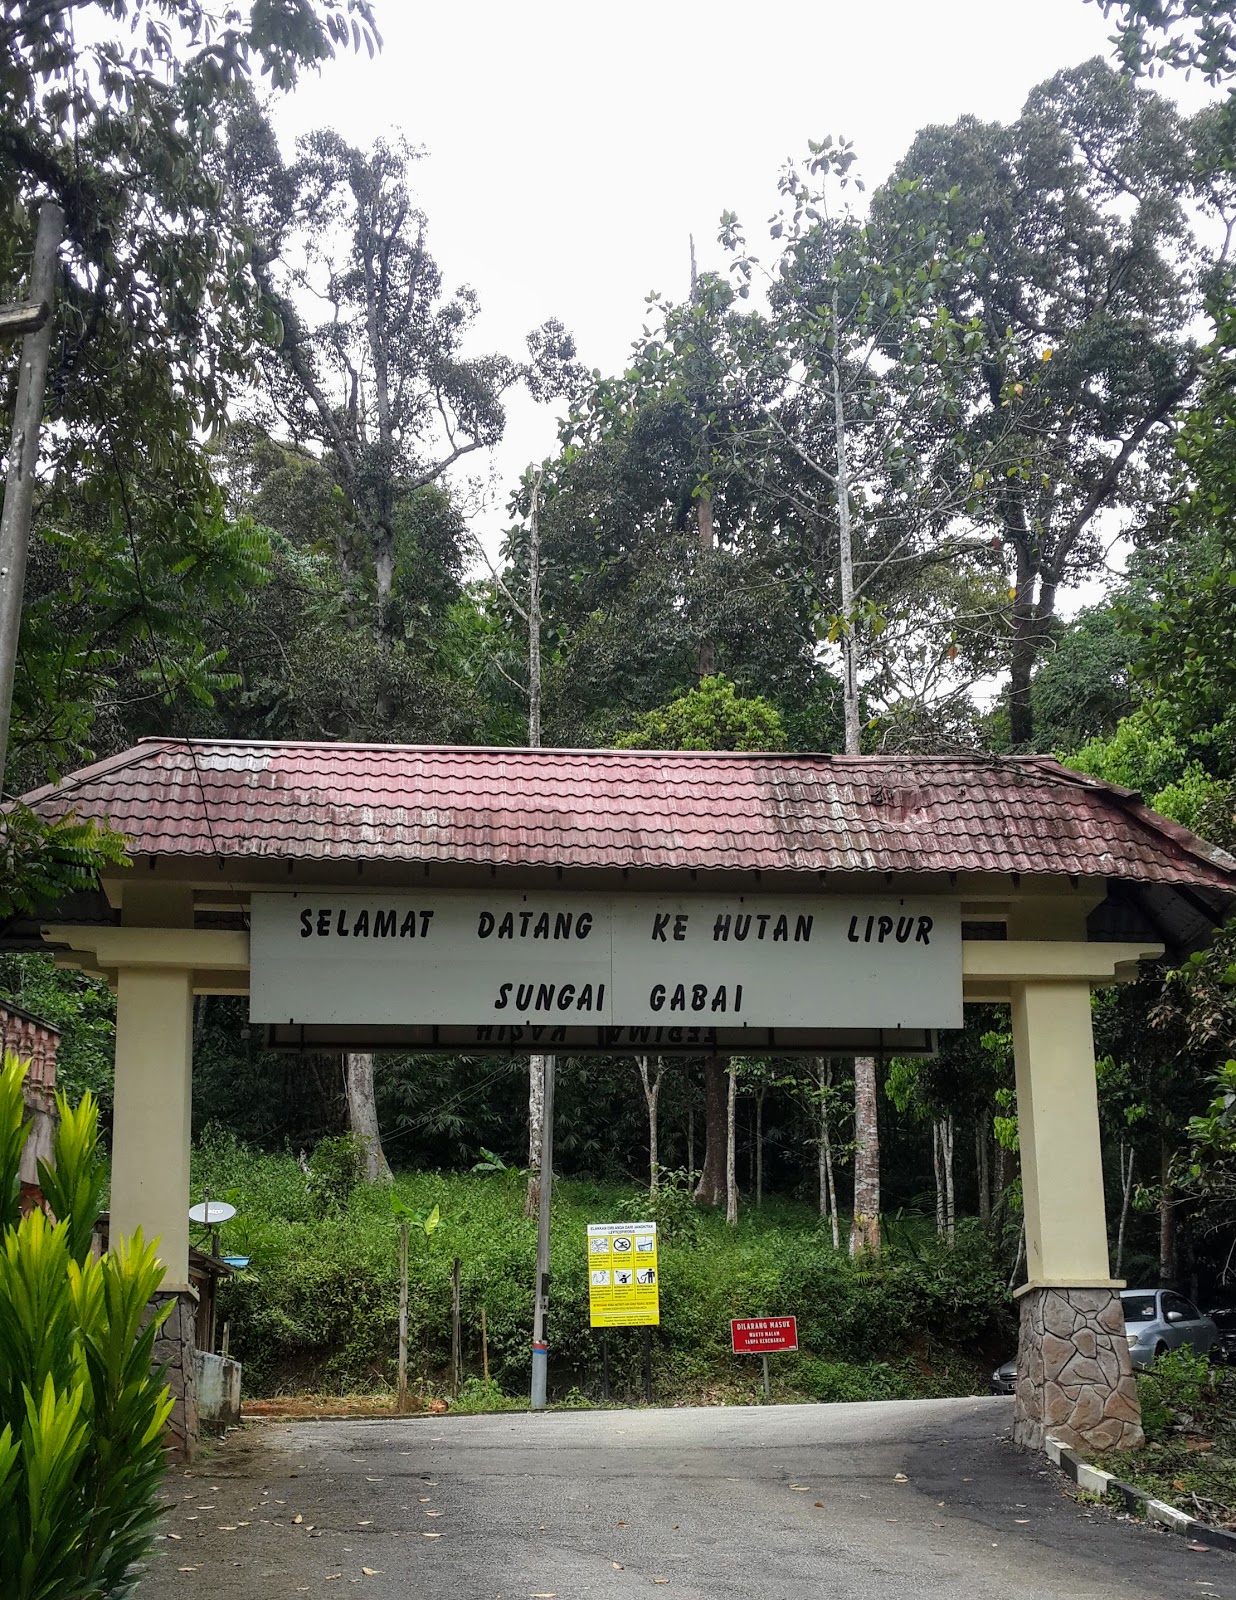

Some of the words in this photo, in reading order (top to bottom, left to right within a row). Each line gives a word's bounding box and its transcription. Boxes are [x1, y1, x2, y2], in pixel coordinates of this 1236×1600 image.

[300, 909, 434, 938] SELAMAT
[478, 911, 593, 940] DATANG
[652, 913, 689, 942] KE
[713, 914, 814, 942] HUTAN
[847, 915, 934, 945] LIPUR
[494, 983, 605, 1012] SUNGAI
[649, 984, 743, 1013] GABAI
[737, 1322, 767, 1330] DILARANG
